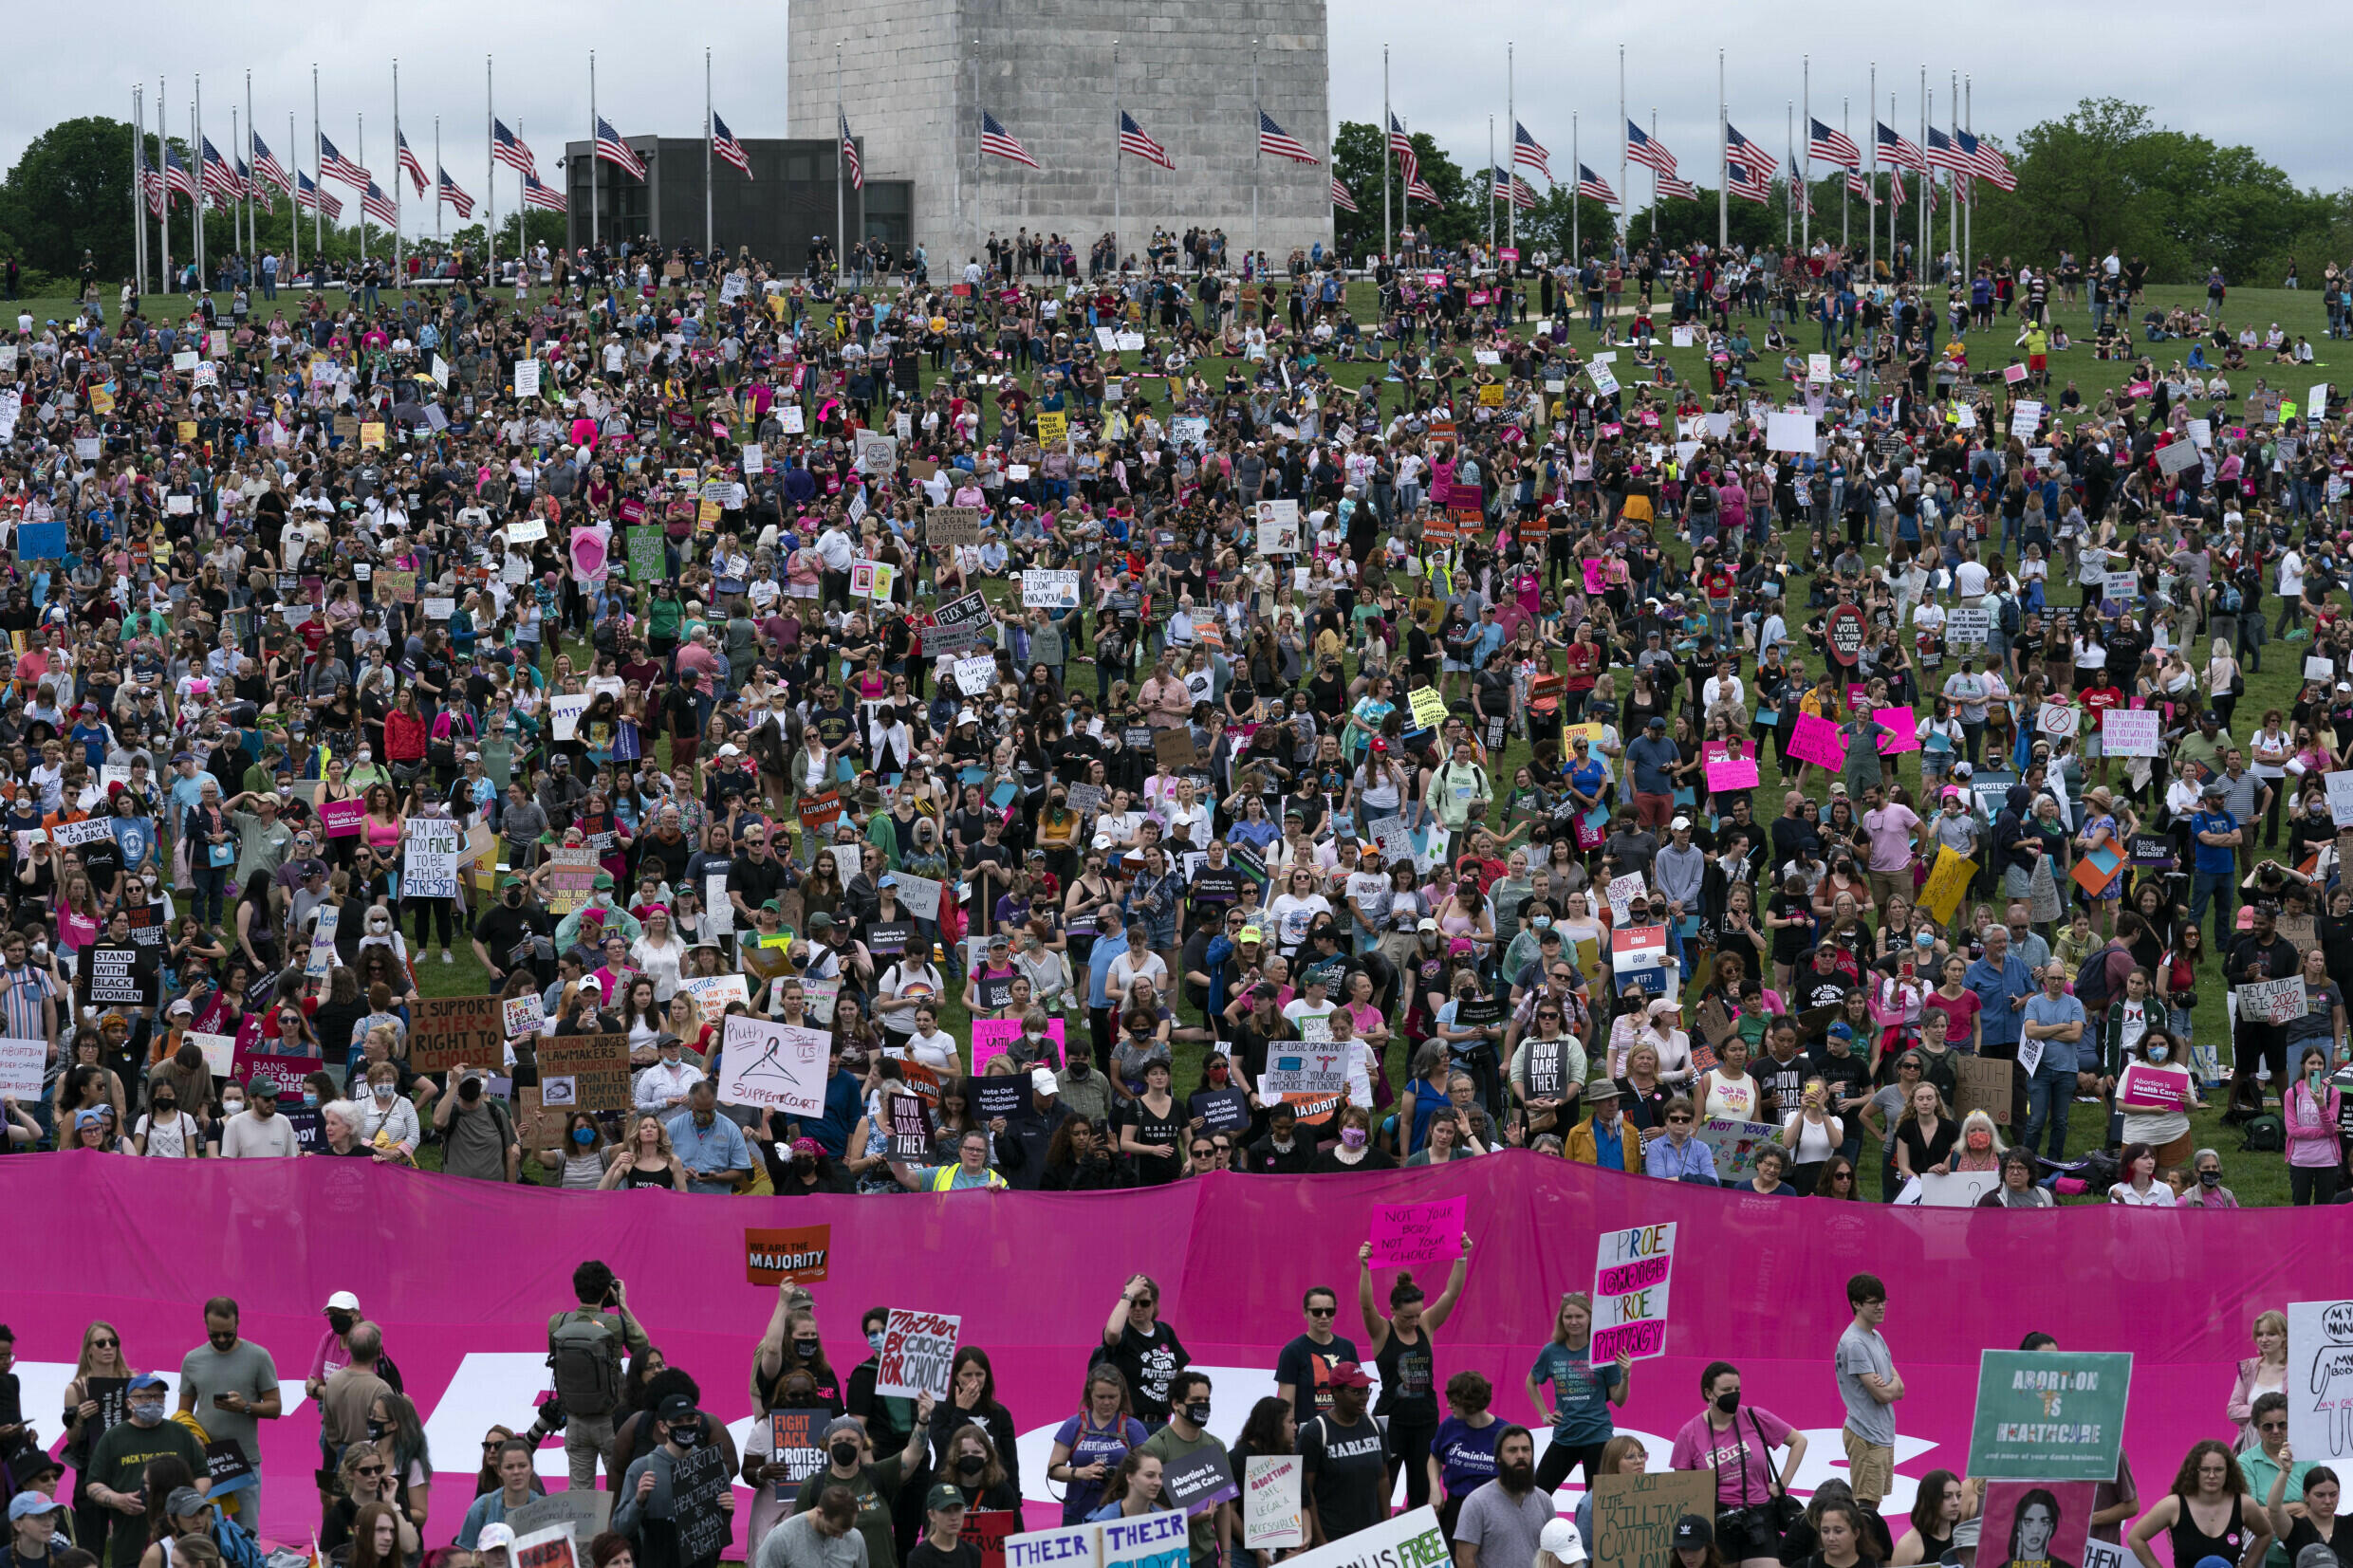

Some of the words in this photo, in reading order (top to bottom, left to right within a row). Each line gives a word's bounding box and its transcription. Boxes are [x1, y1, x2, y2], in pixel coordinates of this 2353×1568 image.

[727, 274, 744, 284] ABORT
[629, 537, 663, 546] FREEDOM
[630, 545, 661, 556] BEGINS
[638, 567, 660, 580] BODY
[960, 598, 979, 613] THE
[1837, 623, 1858, 633] VOTE
[1838, 642, 1858, 651] VOICE
[558, 707, 583, 718] 1973
[1490, 716, 1505, 727] HOW
[1488, 727, 1503, 737] DARE
[1487, 737, 1502, 747] THEY.
[803, 799, 839, 815] MAJORITY
[59, 825, 75, 837] WE
[79, 819, 112, 833] WON'T
[328, 818, 349, 826] Health
[68, 835, 82, 843] GO
[83, 831, 110, 841] BACK
[409, 838, 426, 852] TOO
[429, 838, 455, 854] FINE
[415, 855, 428, 866] TO
[431, 854, 446, 866] BE
[405, 878, 455, 896] STRESSED
[96, 951, 134, 962] STAND
[1632, 954, 1646, 964] GOP
[95, 965, 125, 974] WITH
[1631, 974, 1652, 984] WTF?
[93, 991, 140, 1000] WOMEN
[415, 1003, 424, 1018] I
[430, 998, 495, 1017] SUPPORT
[507, 997, 537, 1011] PROTECT
[508, 1007, 529, 1020] SAFE
[509, 1014, 538, 1027] LEGAL
[438, 1016, 478, 1032] HER
[510, 1021, 545, 1035] ABORTION
[728, 1023, 763, 1042] Ruth
[416, 1032, 469, 1052] RIGHT
[477, 1030, 497, 1047] TO
[538, 1038, 584, 1050] RELIGION
[592, 1037, 627, 1047] JUDGES
[1269, 1042, 1284, 1052] THE
[1288, 1042, 1307, 1052] LOGIC
[1309, 1043, 1319, 1052] OF
[1319, 1043, 1329, 1052] AN
[1330, 1043, 1345, 1052] IDIOT
[425, 1047, 493, 1068] CHOOSE
[546, 1048, 617, 1061] LAWMAKERS
[1533, 1044, 1559, 1058] HOW
[253, 1061, 287, 1072] BANS
[547, 1061, 565, 1072] THE
[569, 1059, 629, 1071] INQUISITION
[1531, 1059, 1558, 1074] DARE
[1963, 1061, 2006, 1084] RUTH
[612, 1071, 630, 1081] LET
[1285, 1072, 1302, 1080] BODY
[1326, 1072, 1342, 1080] BODY
[1531, 1075, 1560, 1092] THEY.
[1776, 1071, 1799, 1088] HOW
[2133, 1077, 2163, 1088] Abortion
[2164, 1080, 2170, 1089] is
[579, 1085, 586, 1096] IT
[590, 1084, 627, 1094] HAPPEN
[1961, 1087, 2004, 1103] SENT
[2133, 1084, 2158, 1094] Health
[895, 1097, 919, 1115] HOW
[1205, 1106, 1237, 1116] Anti-Choice
[896, 1117, 925, 1134] DARE
[1208, 1114, 1237, 1123] Politicians
[1709, 1121, 1733, 1132] NOT
[1743, 1123, 1770, 1136] YOUR
[897, 1134, 927, 1154] THEY.
[1385, 1209, 1417, 1223] NOT
[1427, 1207, 1454, 1222] YOUR
[1402, 1224, 1433, 1235] BODY
[750, 1243, 765, 1252] WE
[768, 1244, 787, 1252] ARE
[791, 1243, 809, 1251] THE
[1381, 1237, 1404, 1249] NOT
[1418, 1235, 1445, 1246] YOUR
[1617, 1225, 1667, 1262] PROE
[750, 1250, 825, 1269] MAJORITY
[1389, 1247, 1437, 1262] CHOICE
[1603, 1256, 1666, 1295] CHOICE
[1614, 1288, 1653, 1324] PROE
[890, 1311, 957, 1340] Mother
[884, 1332, 907, 1353] BY
[904, 1335, 954, 1358] CHOICE
[1594, 1320, 1664, 1361] PRIVACY
[879, 1354, 904, 1387] FOR
[904, 1355, 951, 1394] CHOICE
[2011, 1371, 2098, 1391] ABORTION
[775, 1415, 810, 1430] FIGHT
[775, 1432, 811, 1448] BACK.
[1996, 1423, 2101, 1444] HEALTHCARE
[1326, 1436, 1381, 1458] HARLEM
[1450, 1443, 1495, 1462] Feminism
[121, 1454, 139, 1467] PACK
[776, 1448, 827, 1465] PROTECT
[2030, 1453, 2047, 1462] your
[2072, 1453, 2105, 1462] business.
[673, 1447, 724, 1483] ABORTION
[1171, 1468, 1205, 1487] Abortion
[1206, 1464, 1214, 1475] is
[1251, 1462, 1293, 1490] ABORTION
[1175, 1481, 1200, 1498] Health
[1202, 1475, 1223, 1488] Care.
[674, 1474, 727, 1516] HEALTHCARE
[1107, 1515, 1185, 1551] THEIR
[691, 1527, 722, 1559] RIGHT
[1397, 1526, 1448, 1568] FREE
[1008, 1535, 1087, 1567] THEIR
